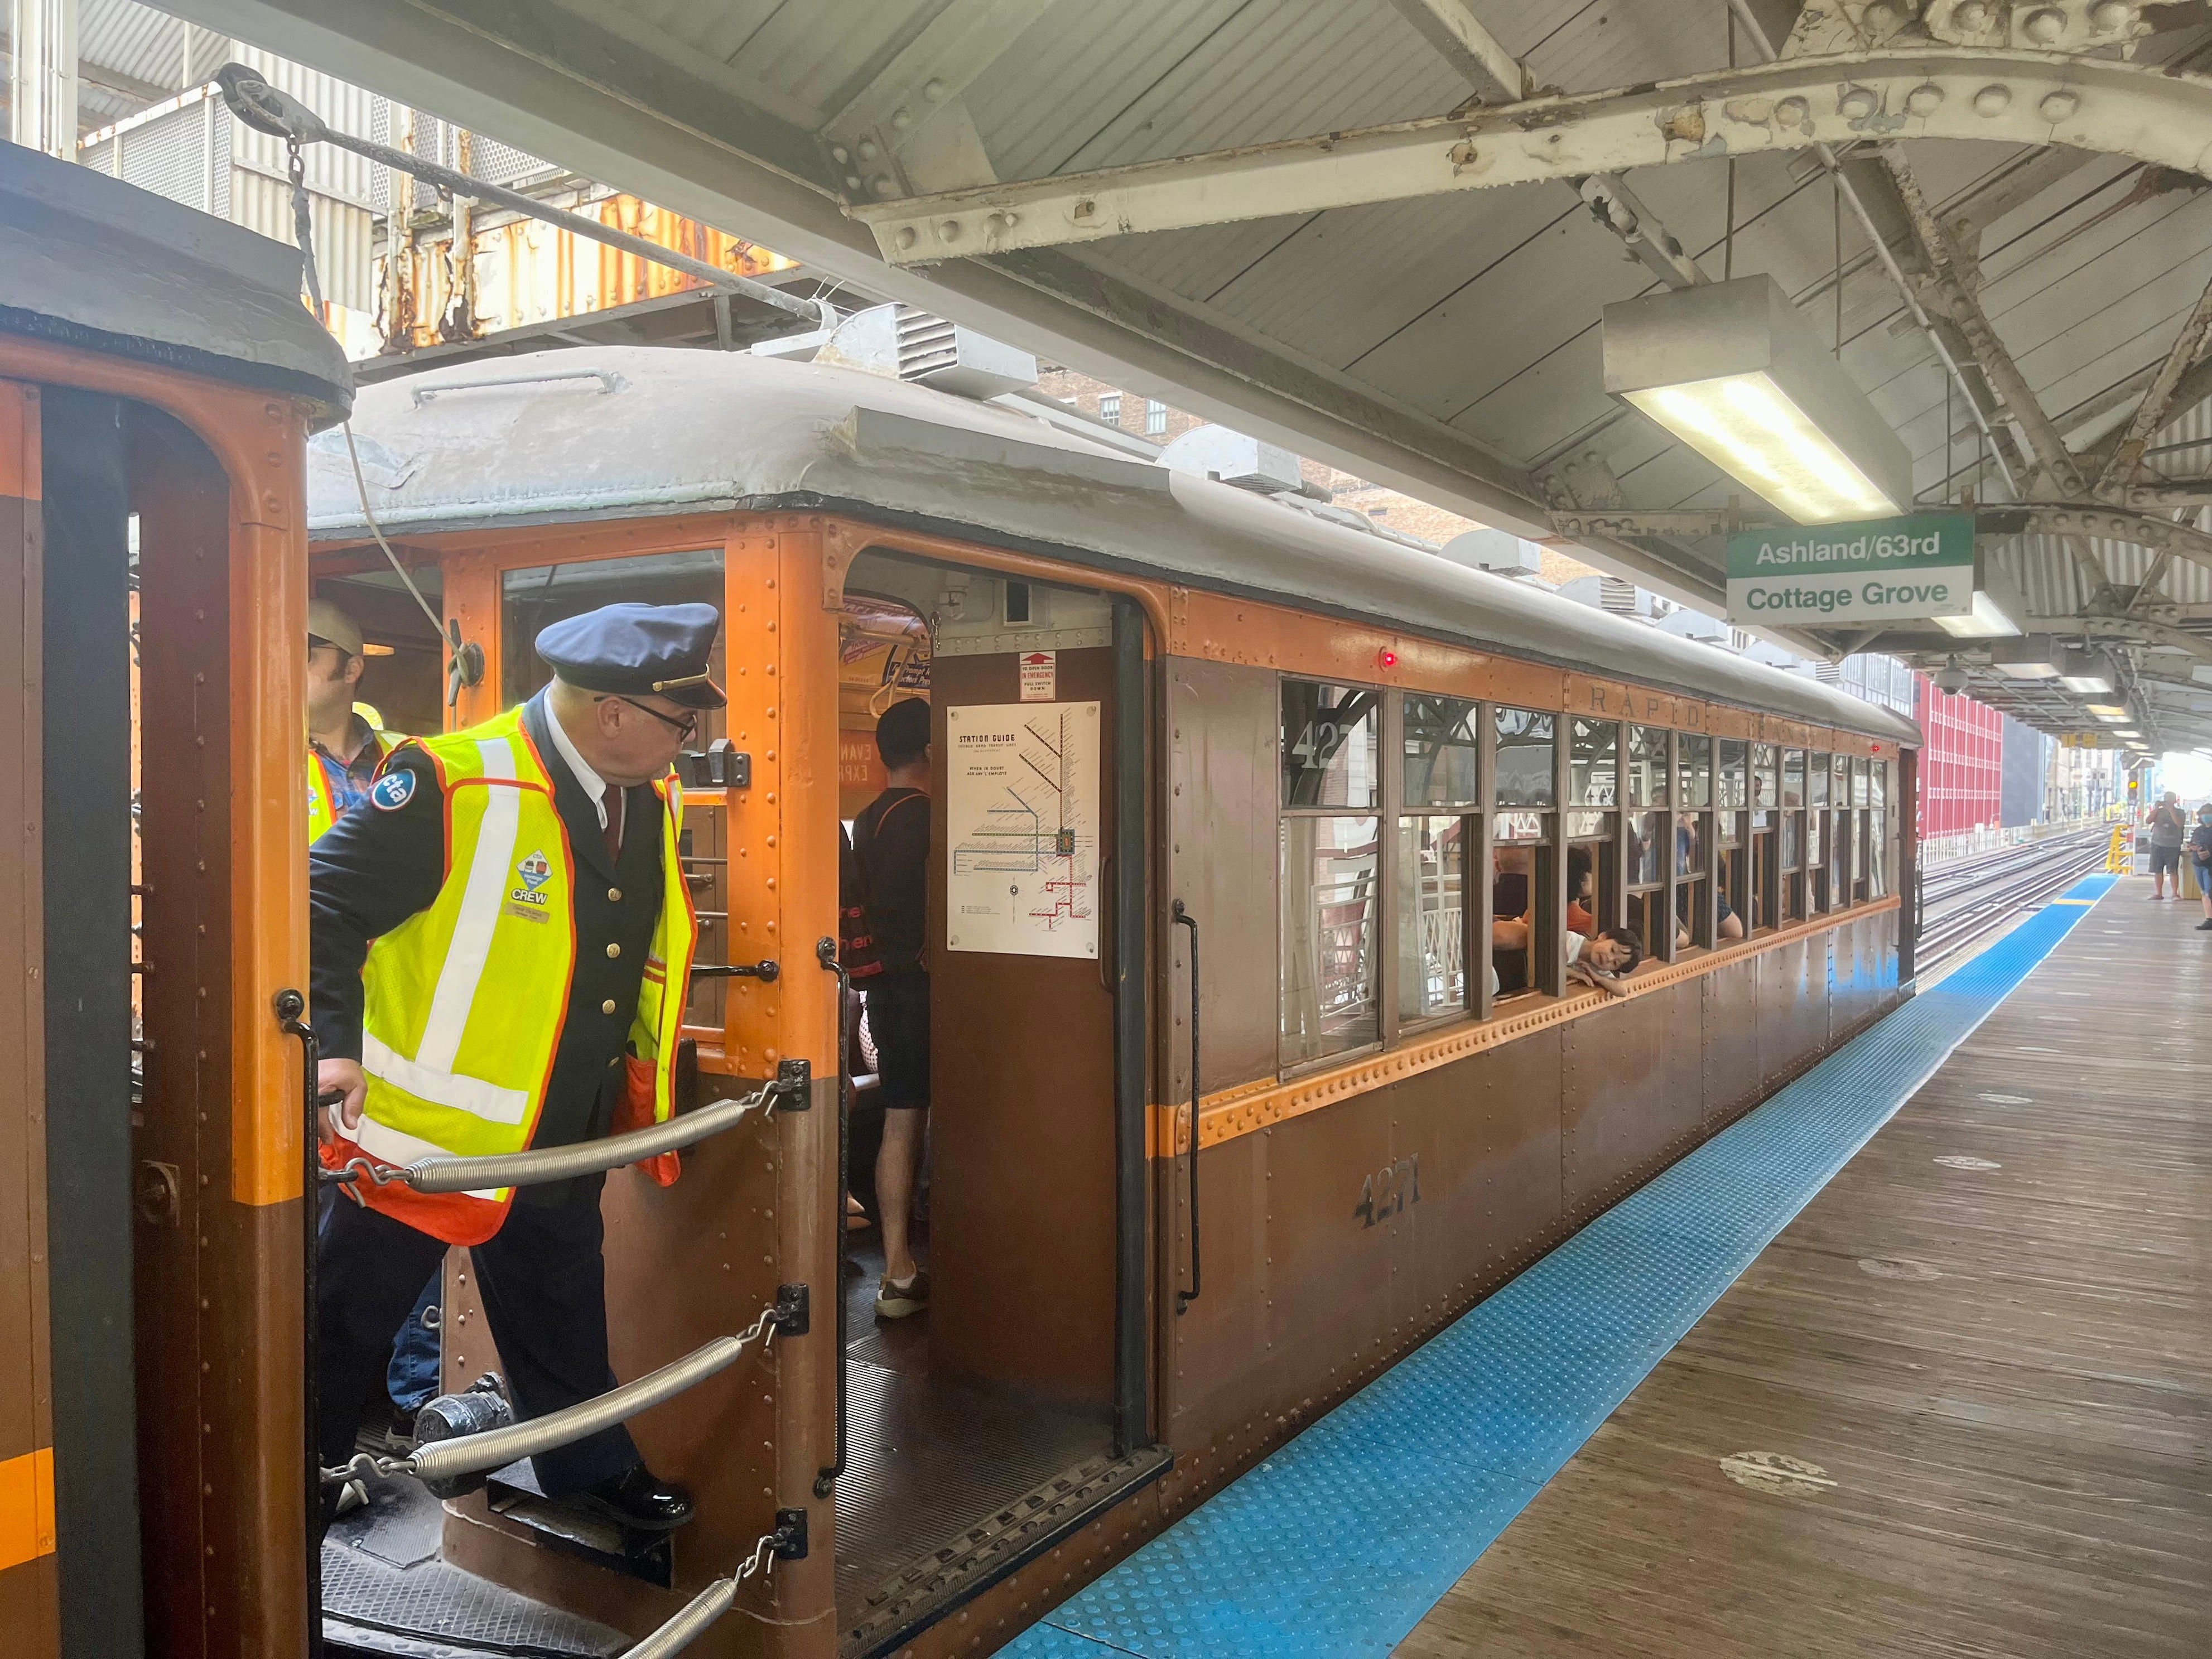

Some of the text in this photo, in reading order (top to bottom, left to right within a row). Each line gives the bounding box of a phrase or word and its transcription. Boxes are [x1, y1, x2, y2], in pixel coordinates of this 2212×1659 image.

[1756, 532, 1940, 565] Ashland/63rd
[1747, 582, 1948, 613] Cottage Grove
[1590, 687, 1699, 726] RAPID
[383, 775, 407, 803] cta
[512, 889, 547, 904] CREW
